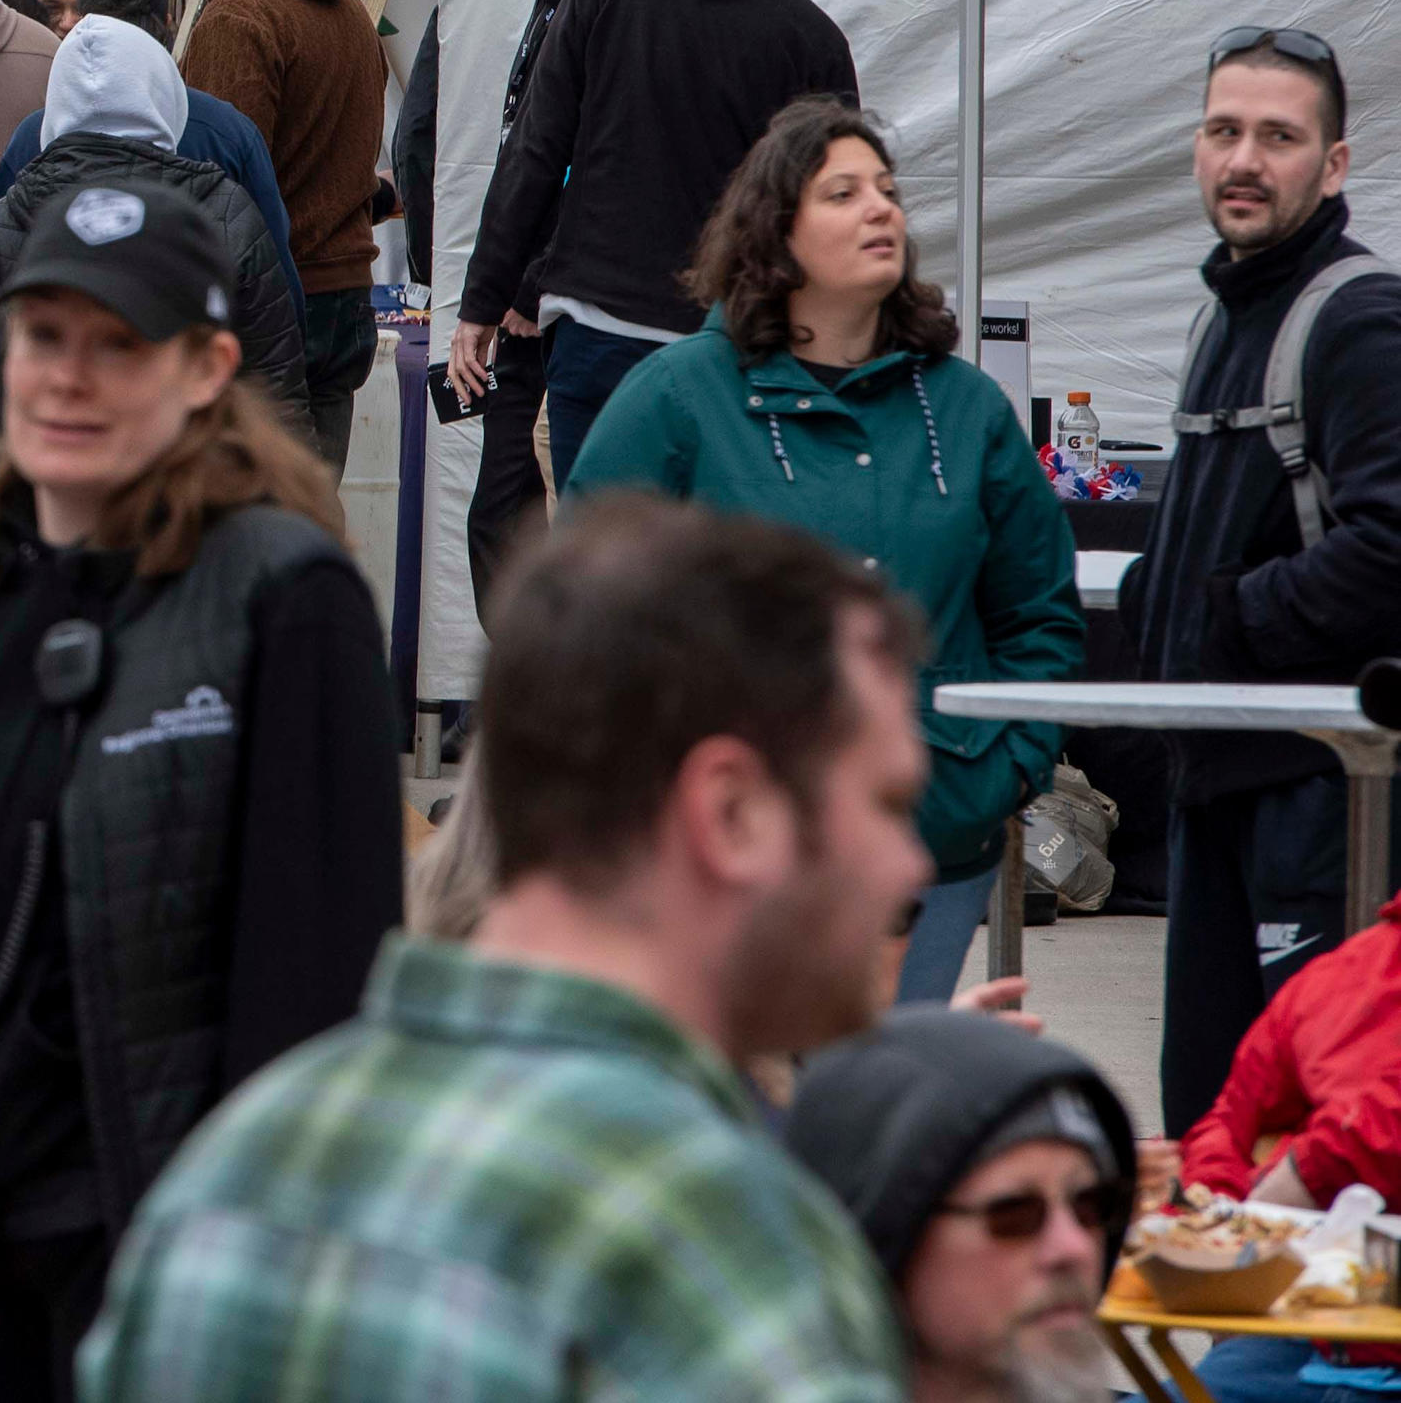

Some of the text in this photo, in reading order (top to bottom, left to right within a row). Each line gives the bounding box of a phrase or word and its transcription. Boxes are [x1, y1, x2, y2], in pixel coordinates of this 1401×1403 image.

[990, 321, 1020, 336] works!
[1068, 435, 1081, 449] G
[1039, 832, 1066, 858] nrg
